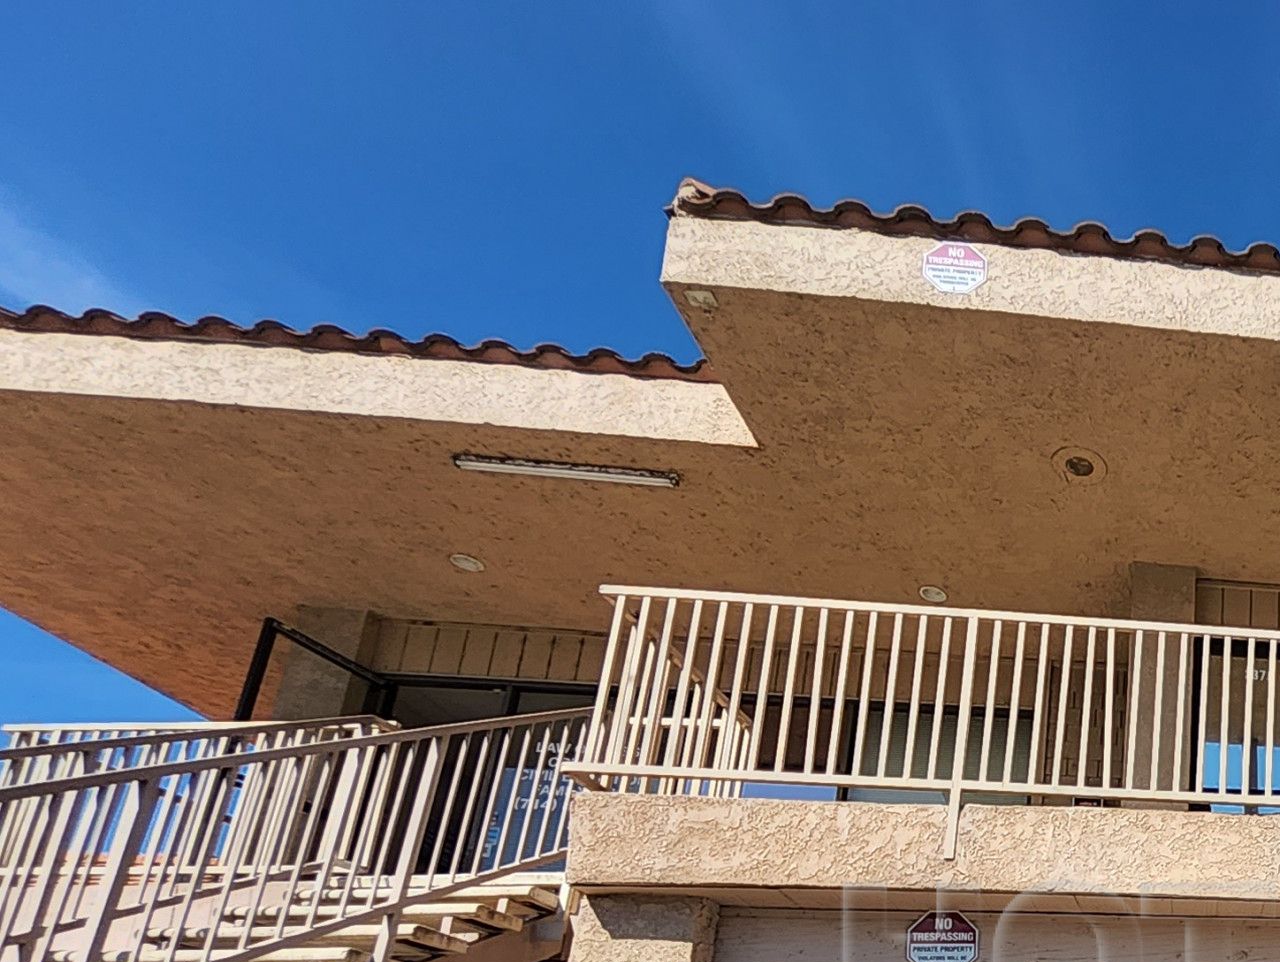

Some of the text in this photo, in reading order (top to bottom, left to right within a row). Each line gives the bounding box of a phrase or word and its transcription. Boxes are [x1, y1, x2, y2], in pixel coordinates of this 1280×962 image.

[948, 247, 965, 258] NO
[935, 918, 952, 930] NO
[912, 932, 974, 942] TRESPASSING
